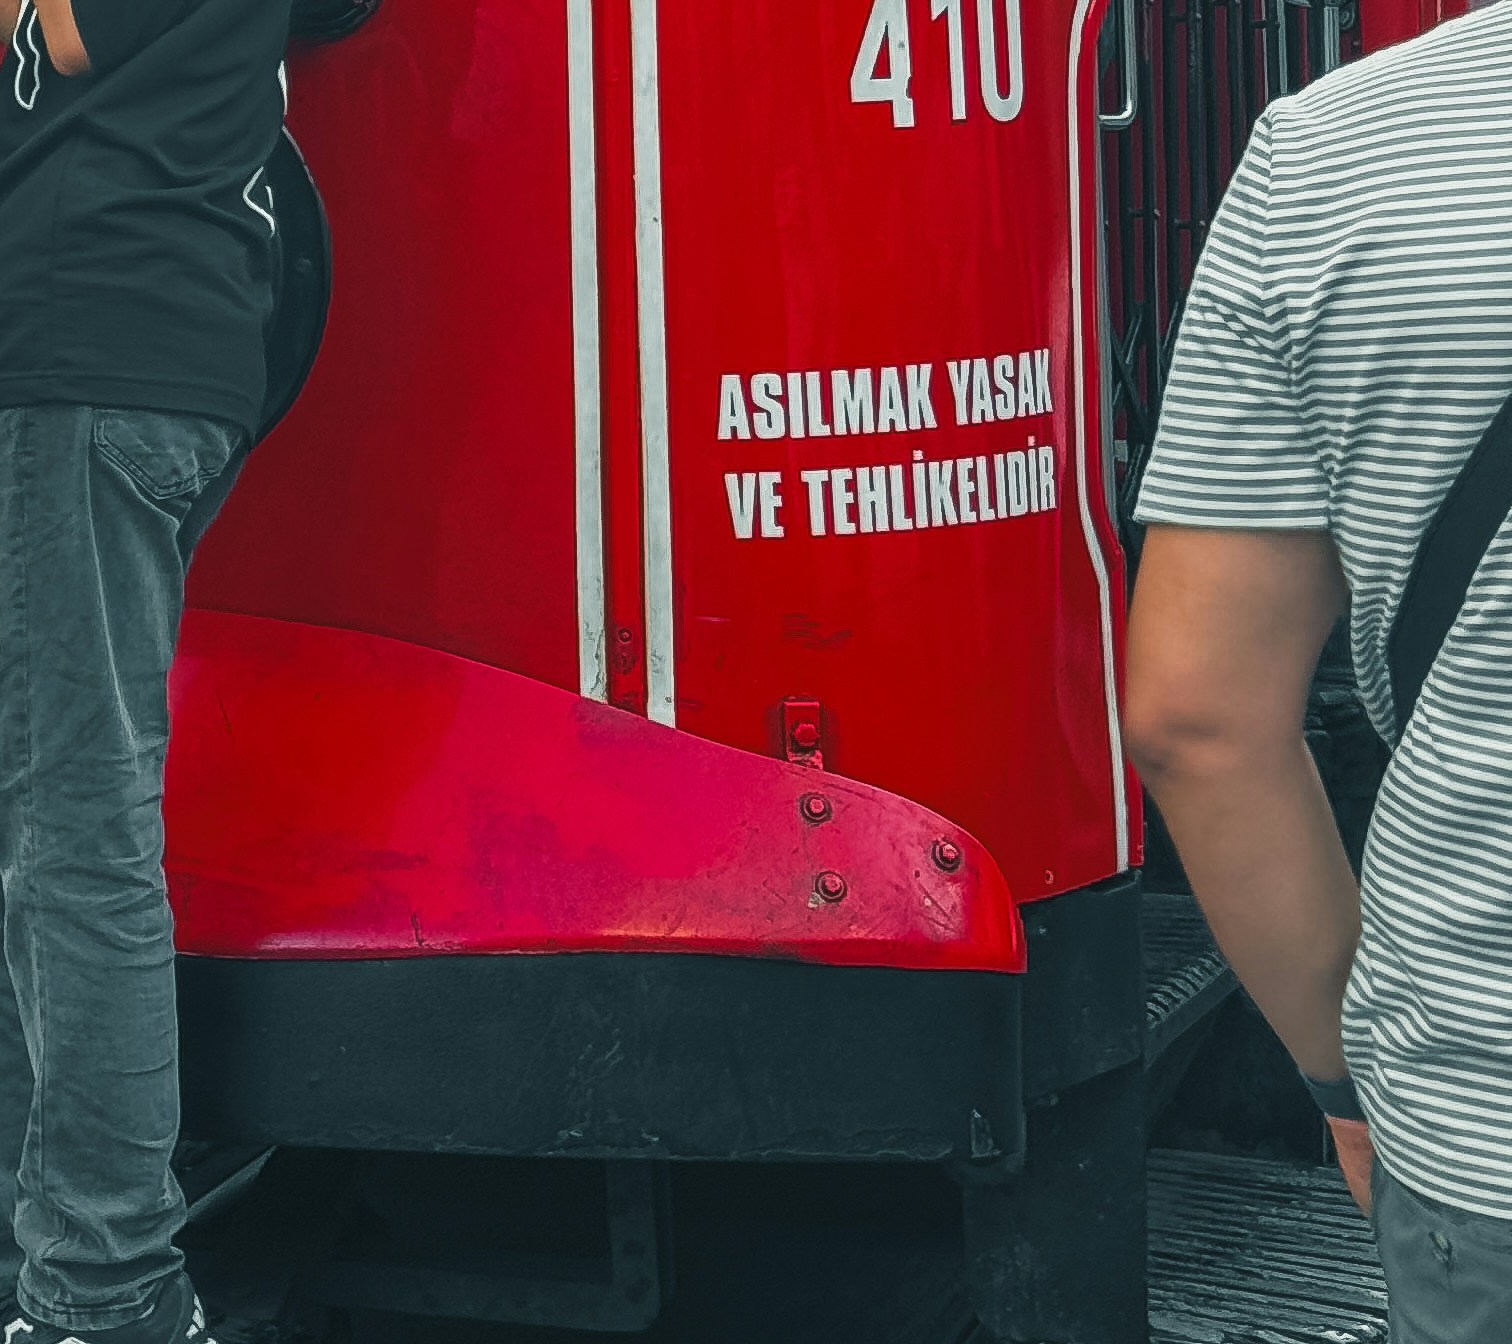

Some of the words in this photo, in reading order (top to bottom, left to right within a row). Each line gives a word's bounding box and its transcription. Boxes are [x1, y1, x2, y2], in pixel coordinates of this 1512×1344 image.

[718, 364, 937, 440] ASILMAK
[947, 349, 1054, 425] YASAK
[725, 470, 784, 540] VE
